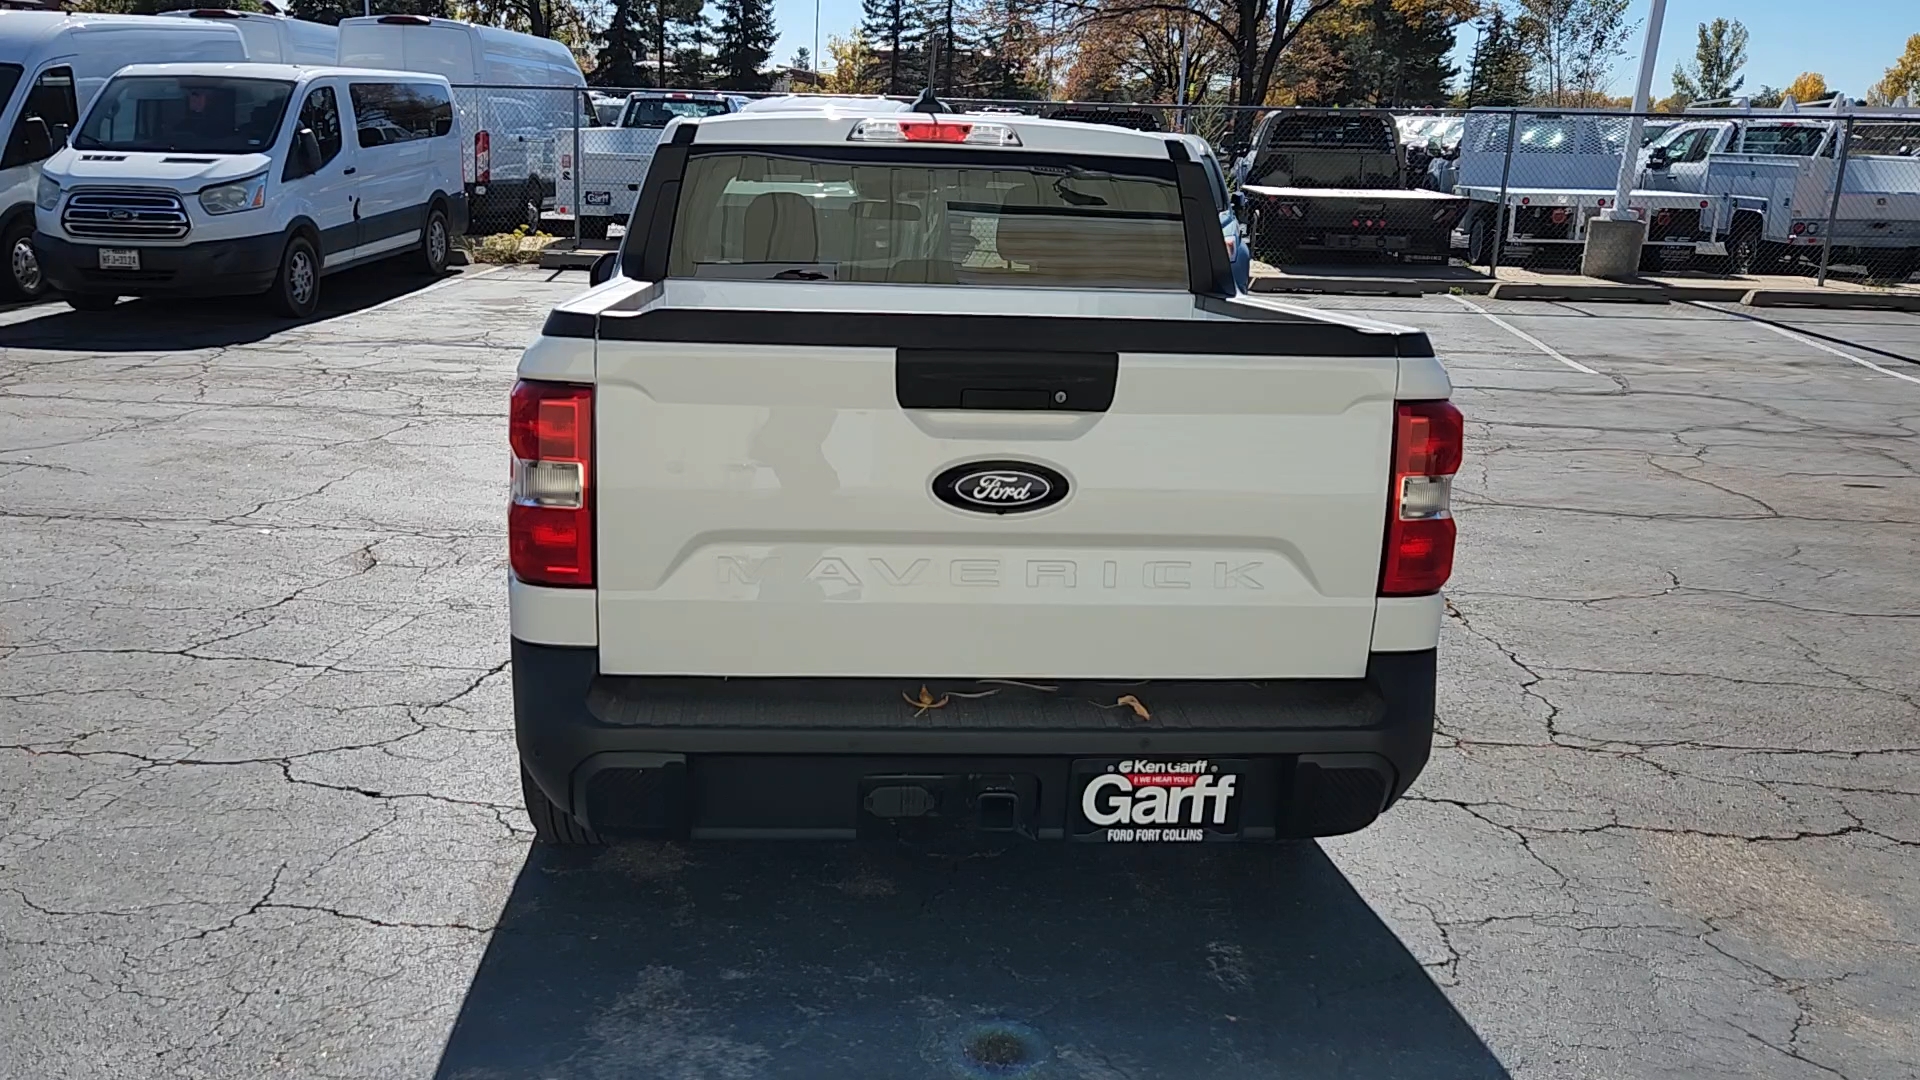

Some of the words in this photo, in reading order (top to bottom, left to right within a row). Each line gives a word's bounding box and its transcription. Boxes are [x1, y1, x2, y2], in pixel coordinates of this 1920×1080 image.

[973, 475, 1032, 500] Ford
[717, 556, 1265, 590] MAVERICK
[1133, 759, 1166, 774] Ken
[1166, 759, 1208, 774] Garff
[1139, 776, 1151, 784] WE
[1152, 776, 1172, 784] HEAR
[1173, 776, 1188, 784] YOU
[1082, 773, 1237, 826] Garff
[1107, 828, 1134, 842] FORD
[1135, 828, 1162, 842] FORT
[1162, 828, 1204, 842] COLLINS
